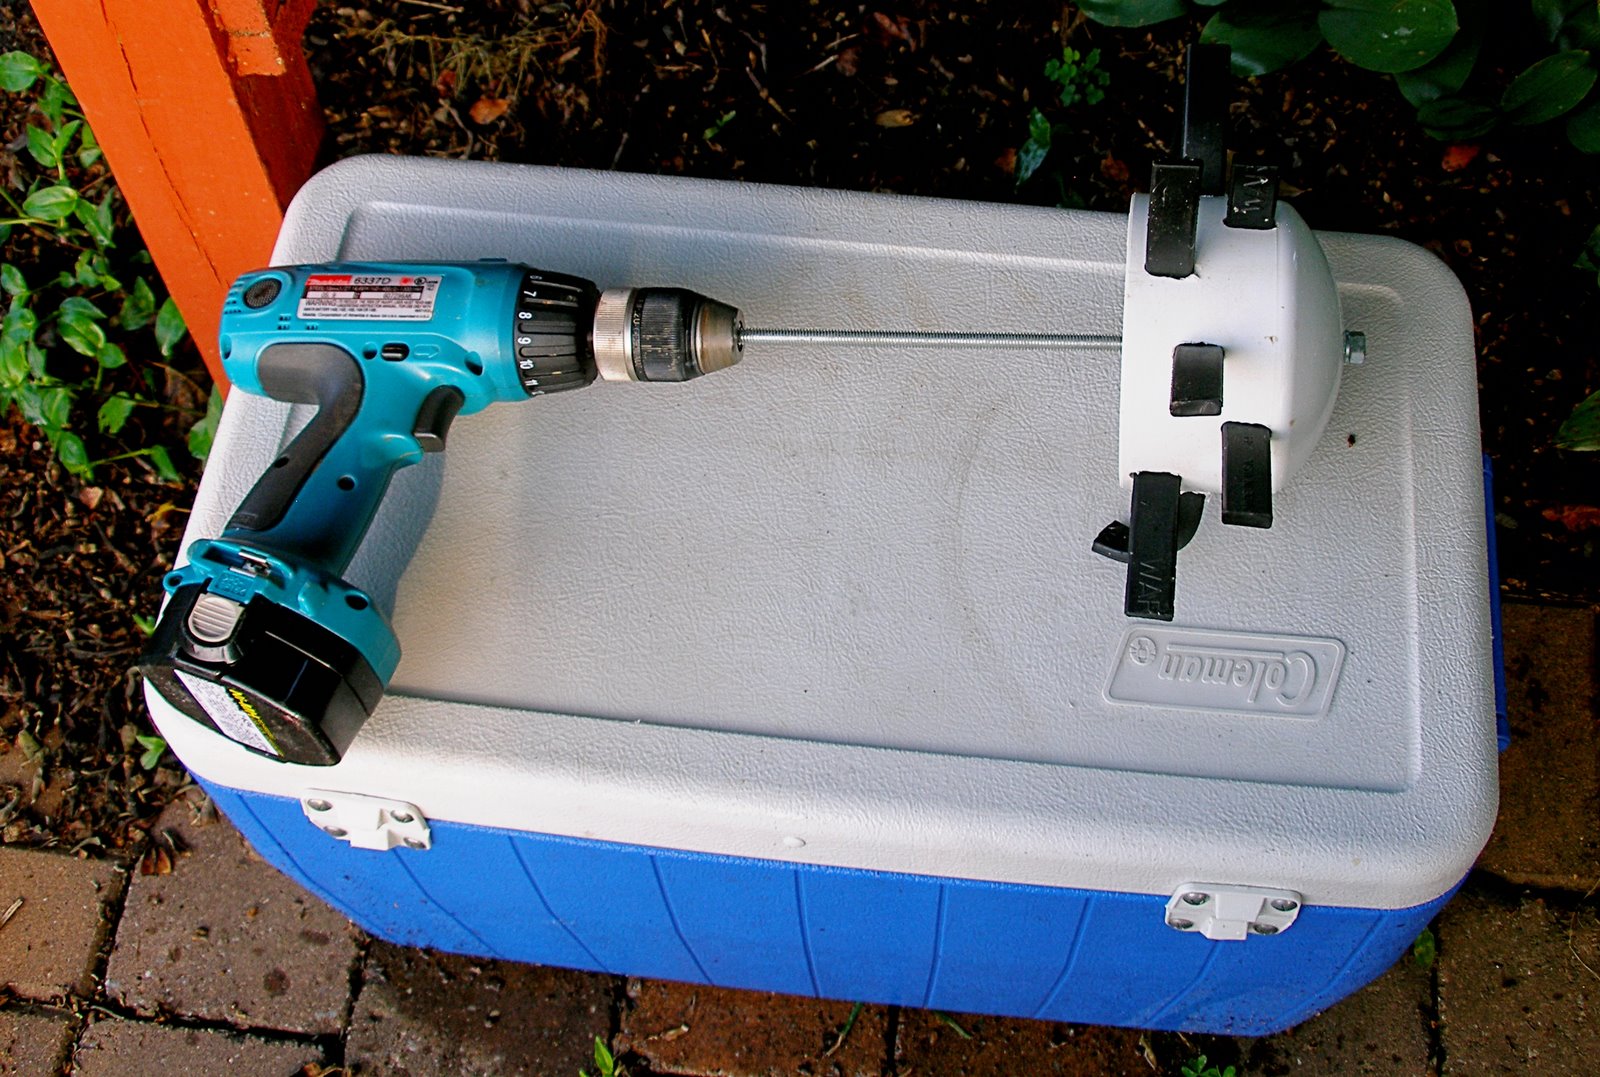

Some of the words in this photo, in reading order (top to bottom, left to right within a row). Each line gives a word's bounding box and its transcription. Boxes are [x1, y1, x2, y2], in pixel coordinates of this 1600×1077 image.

[353, 276, 392, 285] 6337D
[518, 311, 533, 320] 8
[517, 336, 532, 345] 9
[519, 359, 534, 370] 10
[1157, 650, 1316, 708] Coleman
